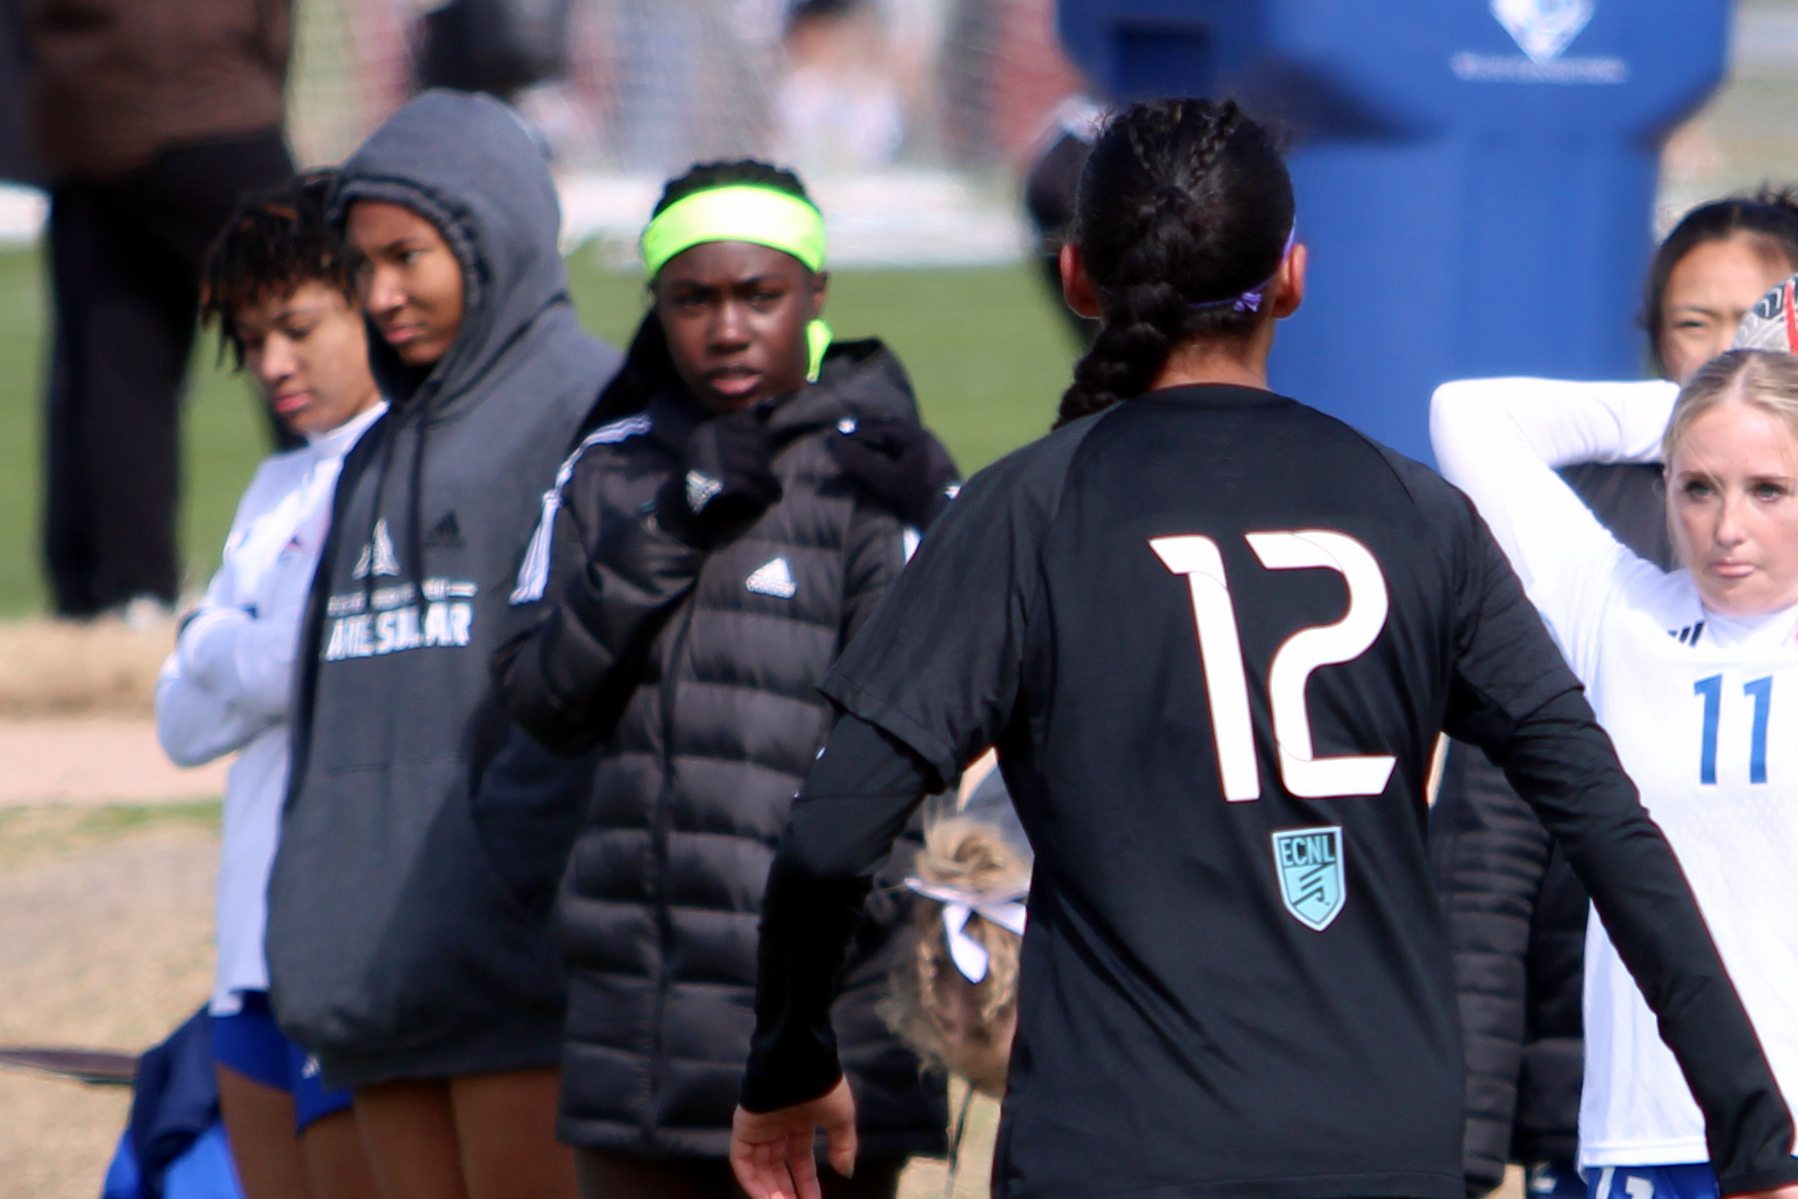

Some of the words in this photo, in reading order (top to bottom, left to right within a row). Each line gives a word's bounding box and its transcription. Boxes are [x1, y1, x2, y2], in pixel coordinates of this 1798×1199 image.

[1148, 528, 1397, 803] 12
[1693, 673, 1773, 785] 11
[1280, 835, 1336, 866] ECNL
